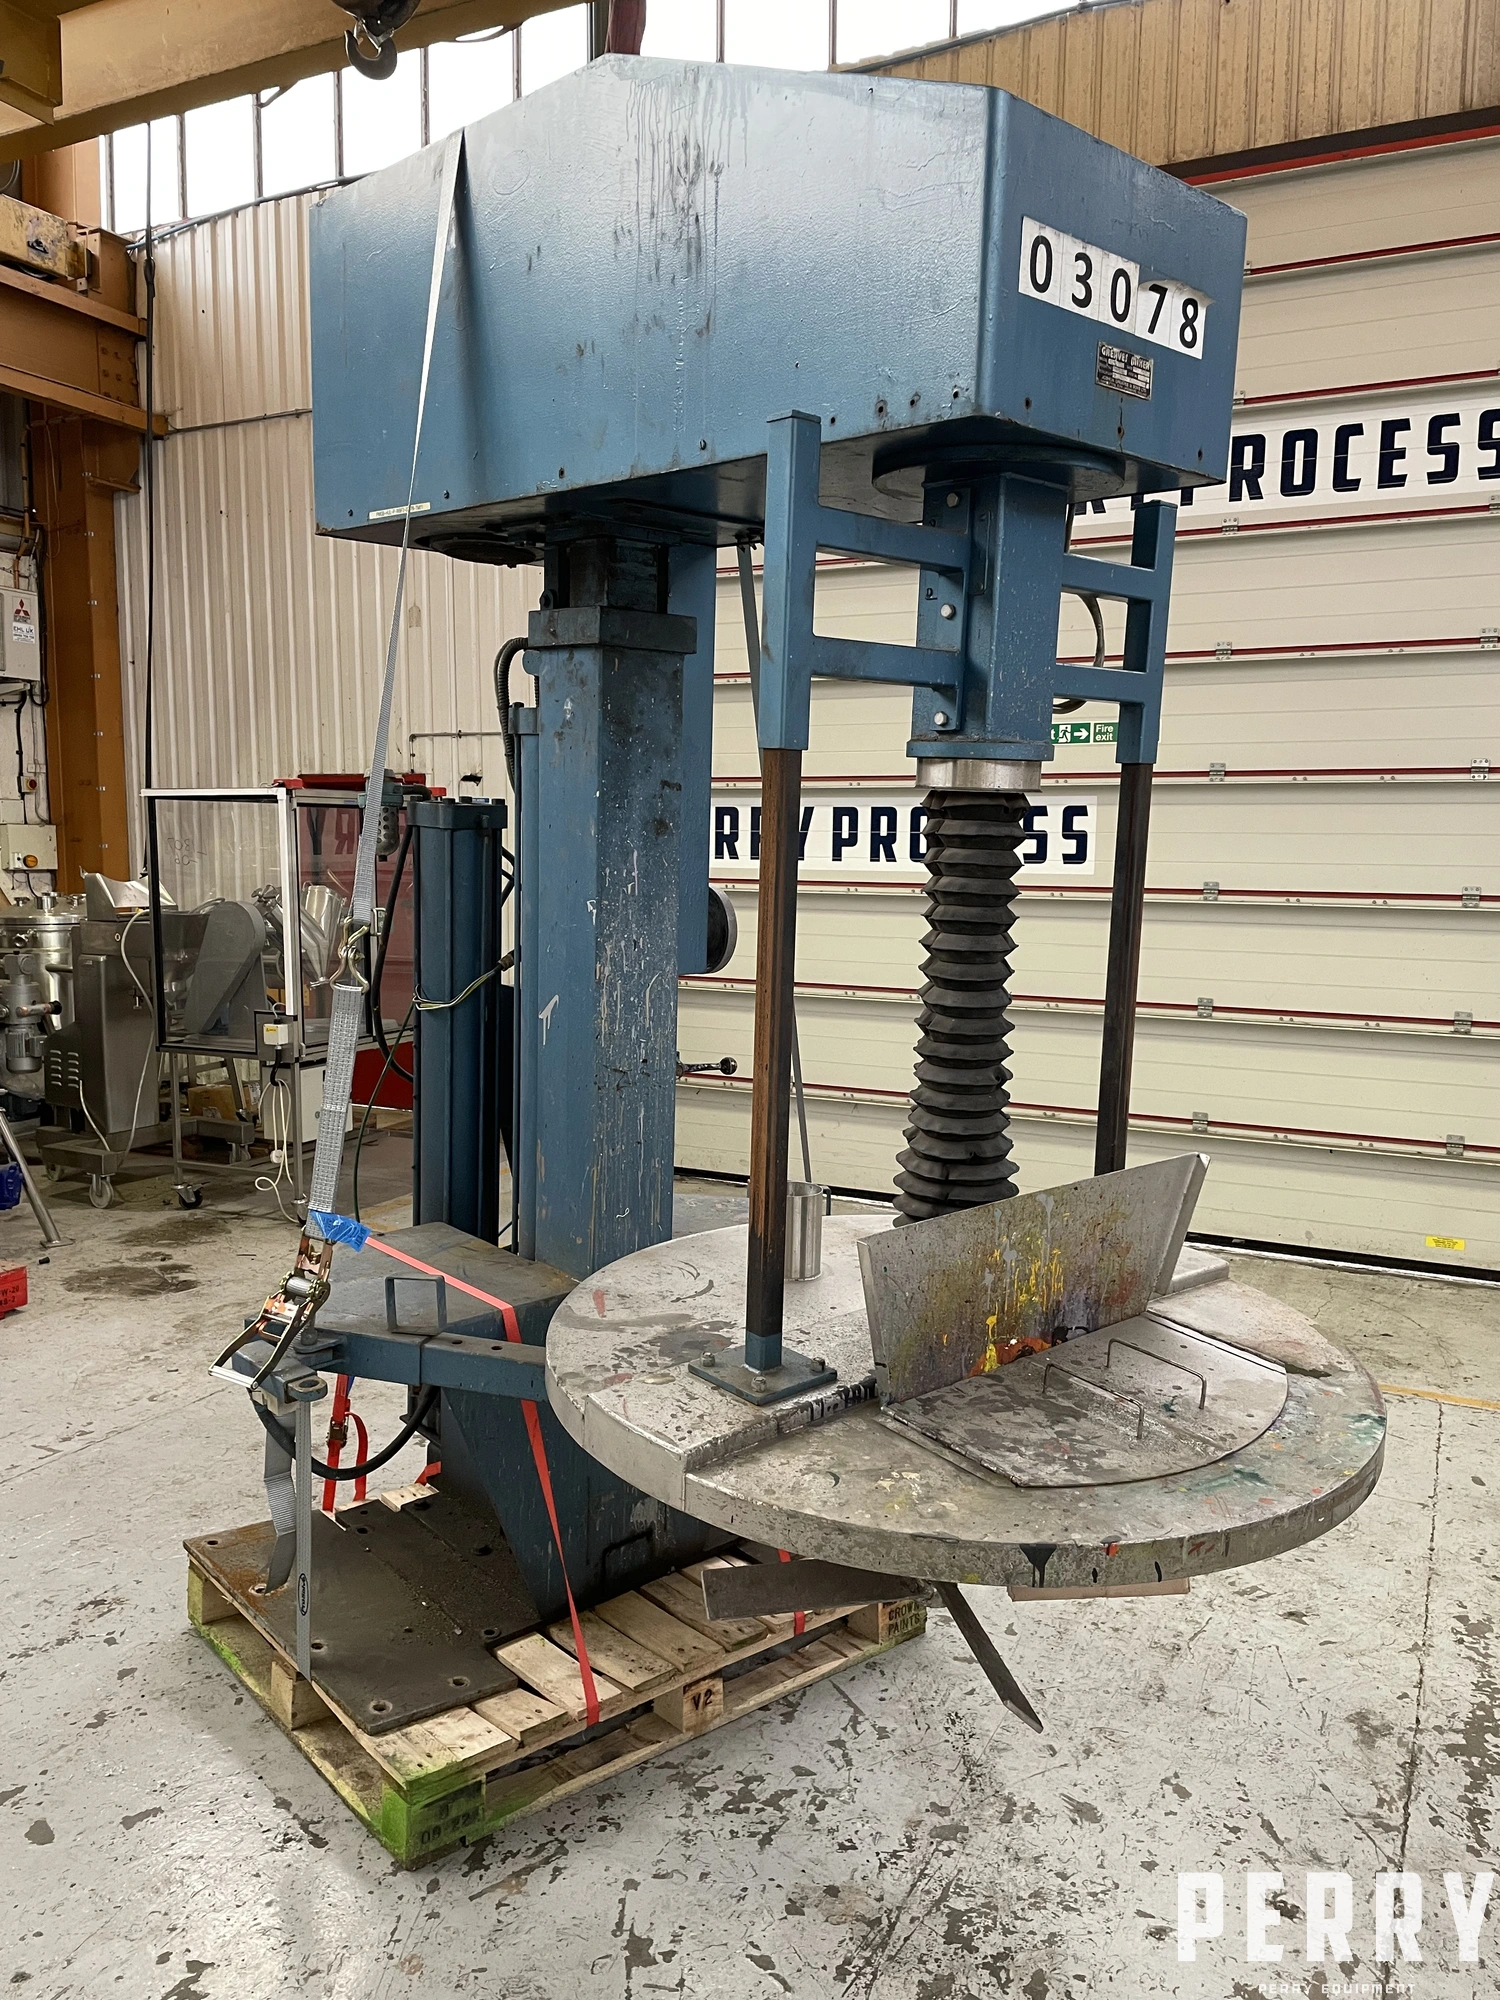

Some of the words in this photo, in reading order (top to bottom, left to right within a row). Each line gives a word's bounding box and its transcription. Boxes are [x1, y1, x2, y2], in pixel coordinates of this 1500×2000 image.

[1029, 234, 1199, 349] 03078
[1180, 408, 1500, 506] ROCESS
[1095, 724, 1114, 733] Fire
[1095, 732, 1113, 741] exit
[831, 805, 1089, 865] PROSS
[888, 1601, 920, 1621] CROWN
[888, 1613, 920, 1636] PAINTS
[692, 1688, 713, 1711] V2
